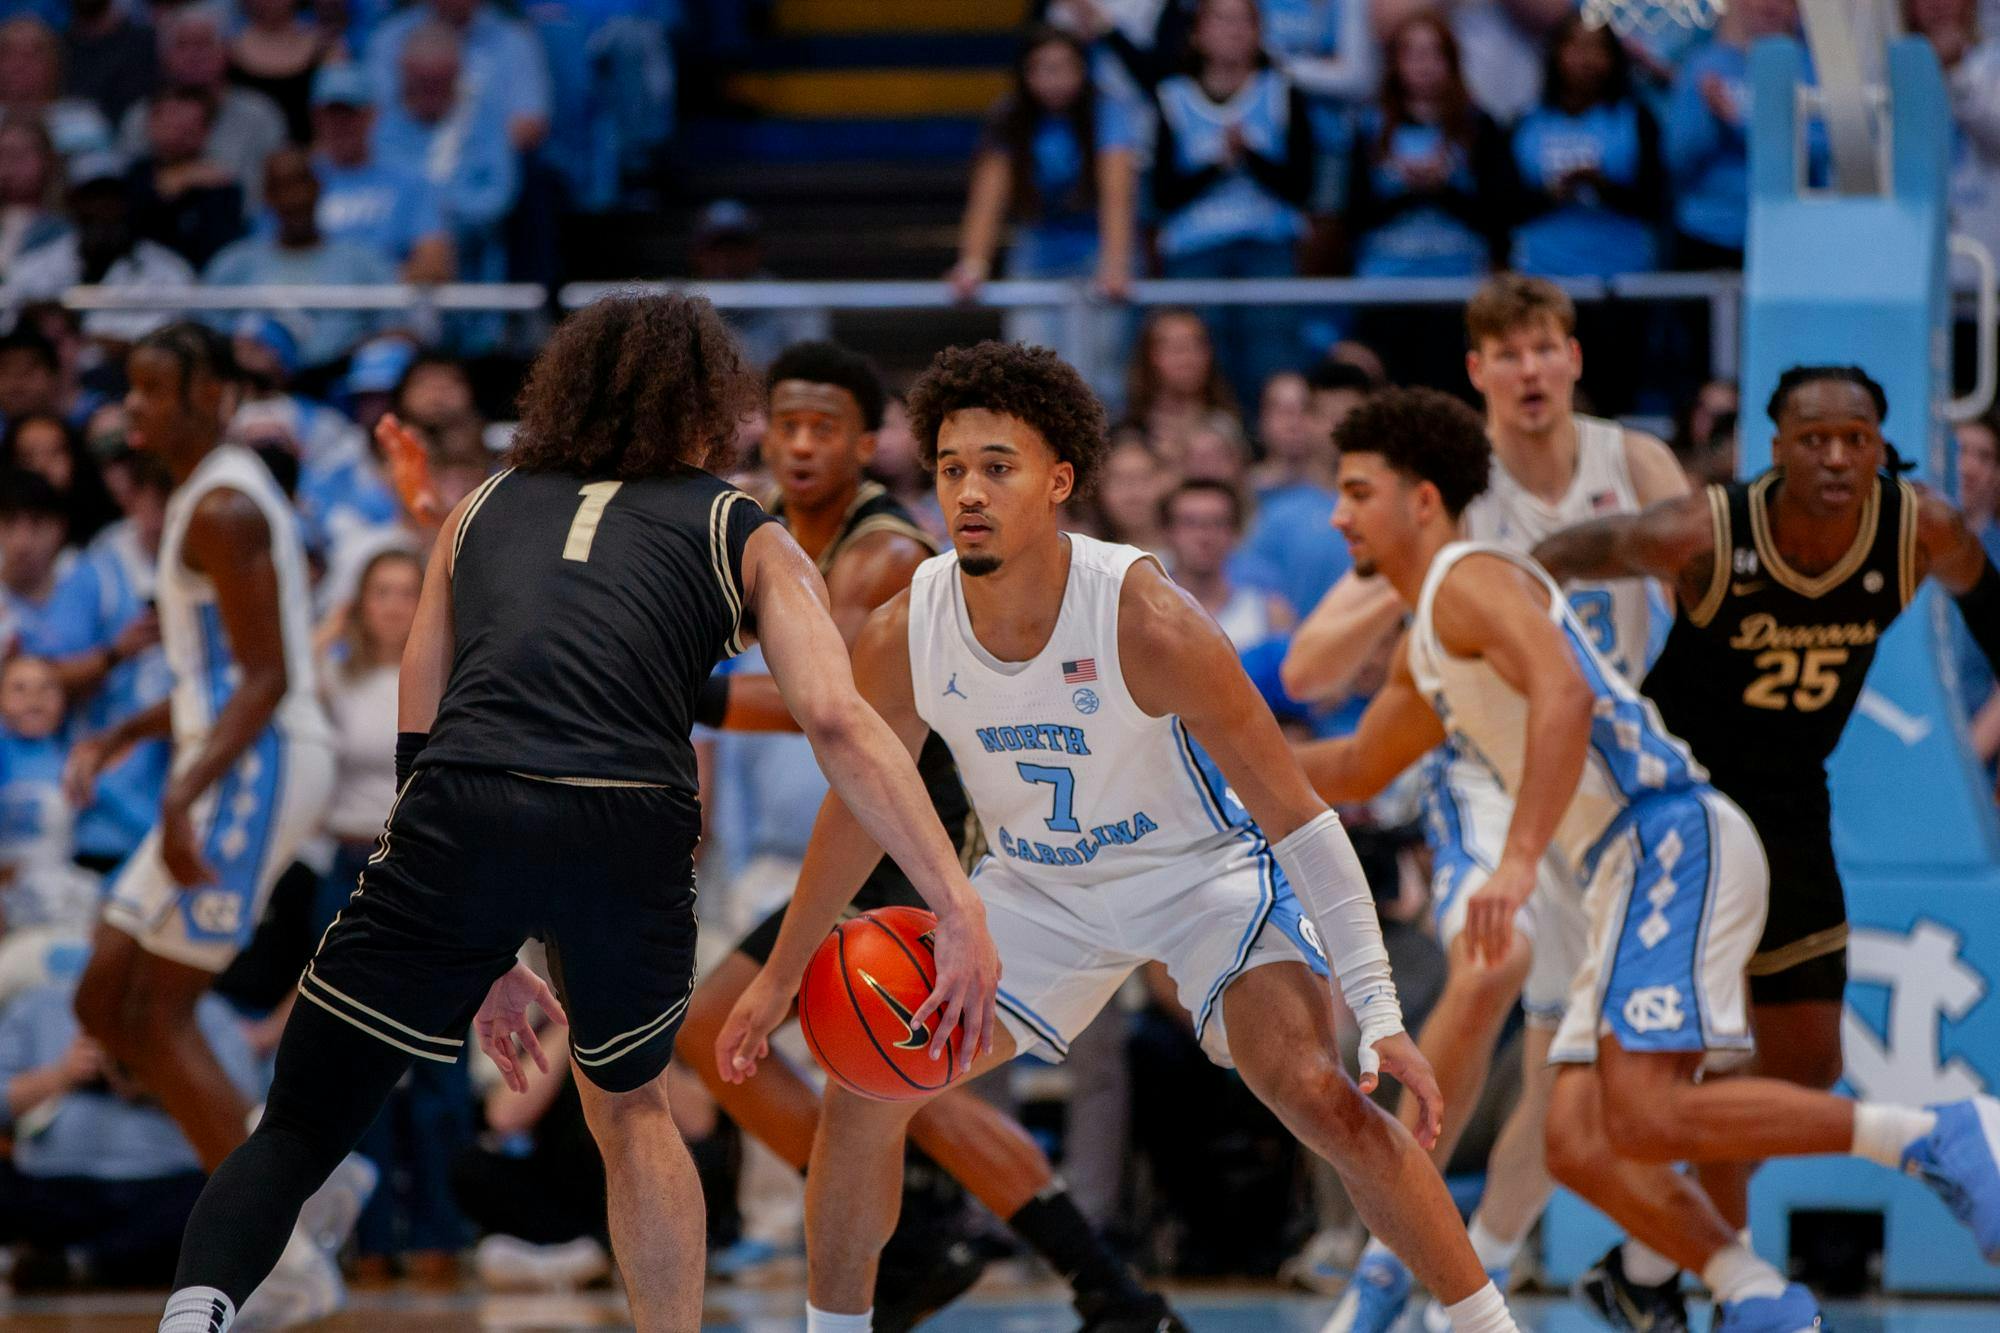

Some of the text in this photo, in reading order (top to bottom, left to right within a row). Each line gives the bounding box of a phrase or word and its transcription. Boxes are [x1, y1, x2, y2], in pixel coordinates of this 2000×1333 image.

[562, 480, 623, 562] 1
[1742, 648, 1849, 712] 25
[976, 723, 1092, 755] NORTH
[1016, 761, 1081, 833] 7
[999, 811, 1159, 866] CAROLINA
